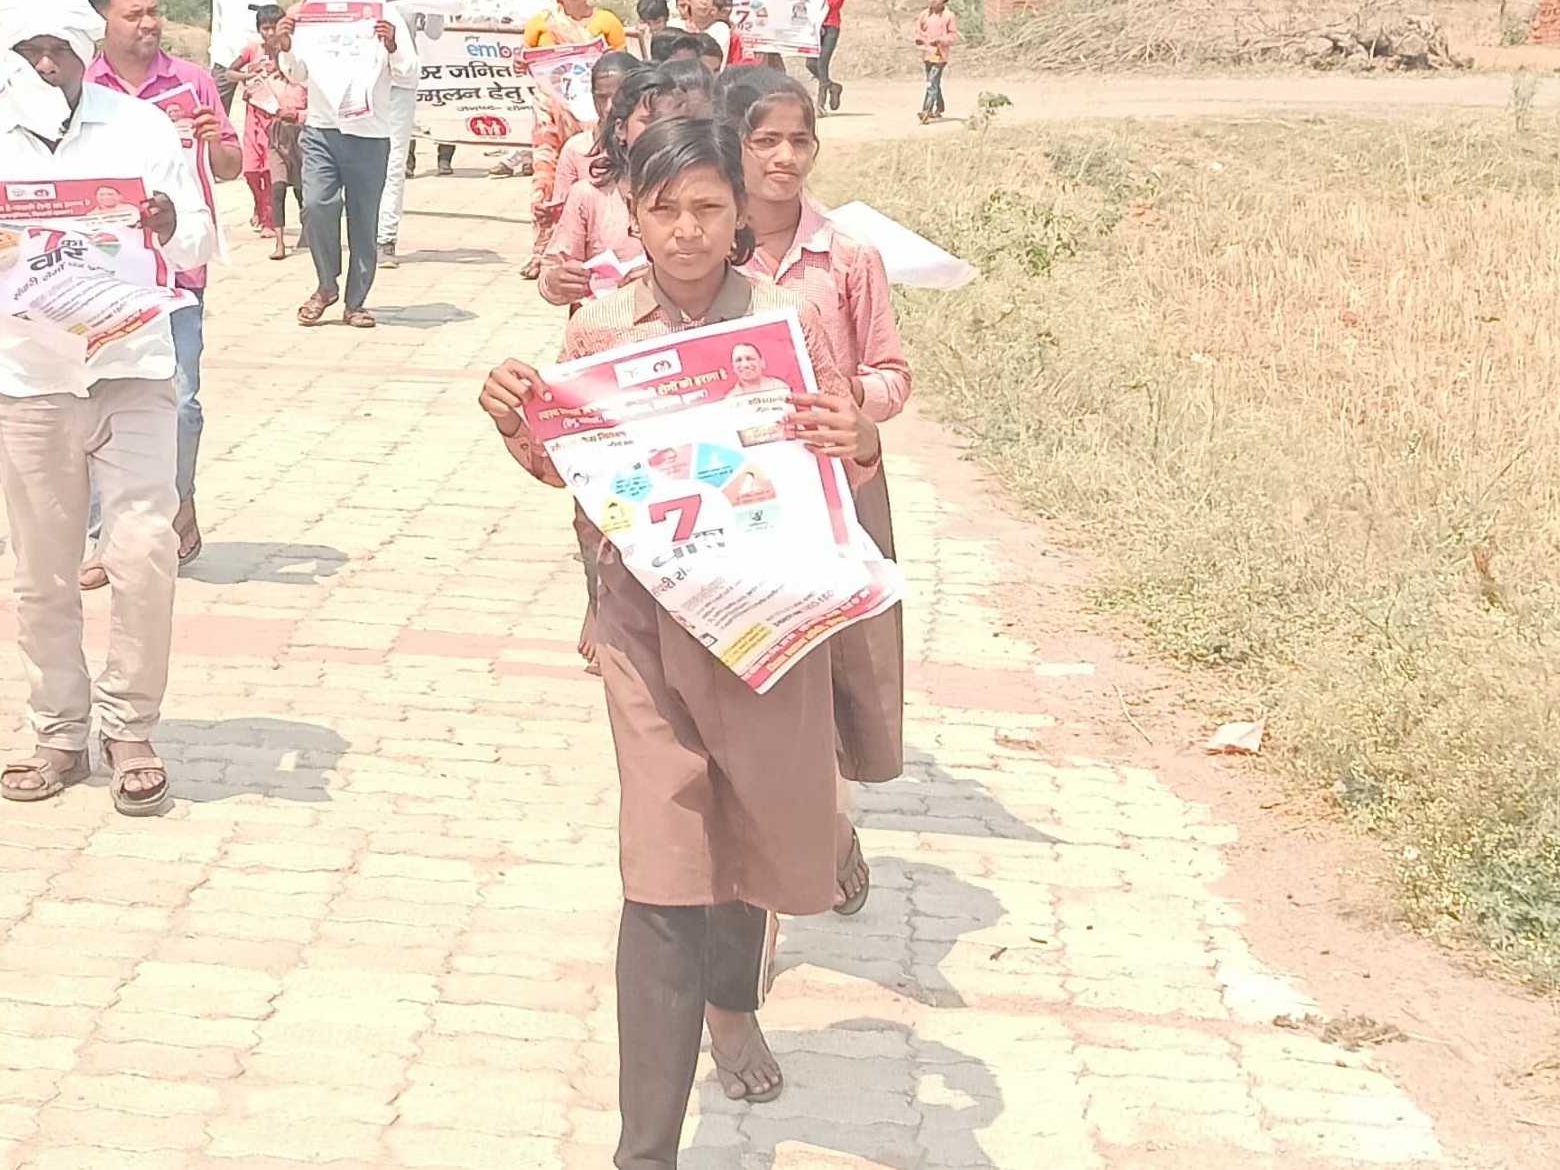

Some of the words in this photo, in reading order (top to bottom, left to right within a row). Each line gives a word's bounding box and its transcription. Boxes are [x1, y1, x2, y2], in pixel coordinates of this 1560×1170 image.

[445, 61, 512, 78] जनित
[487, 81, 526, 104] हेतु
[648, 493, 702, 542] 7
